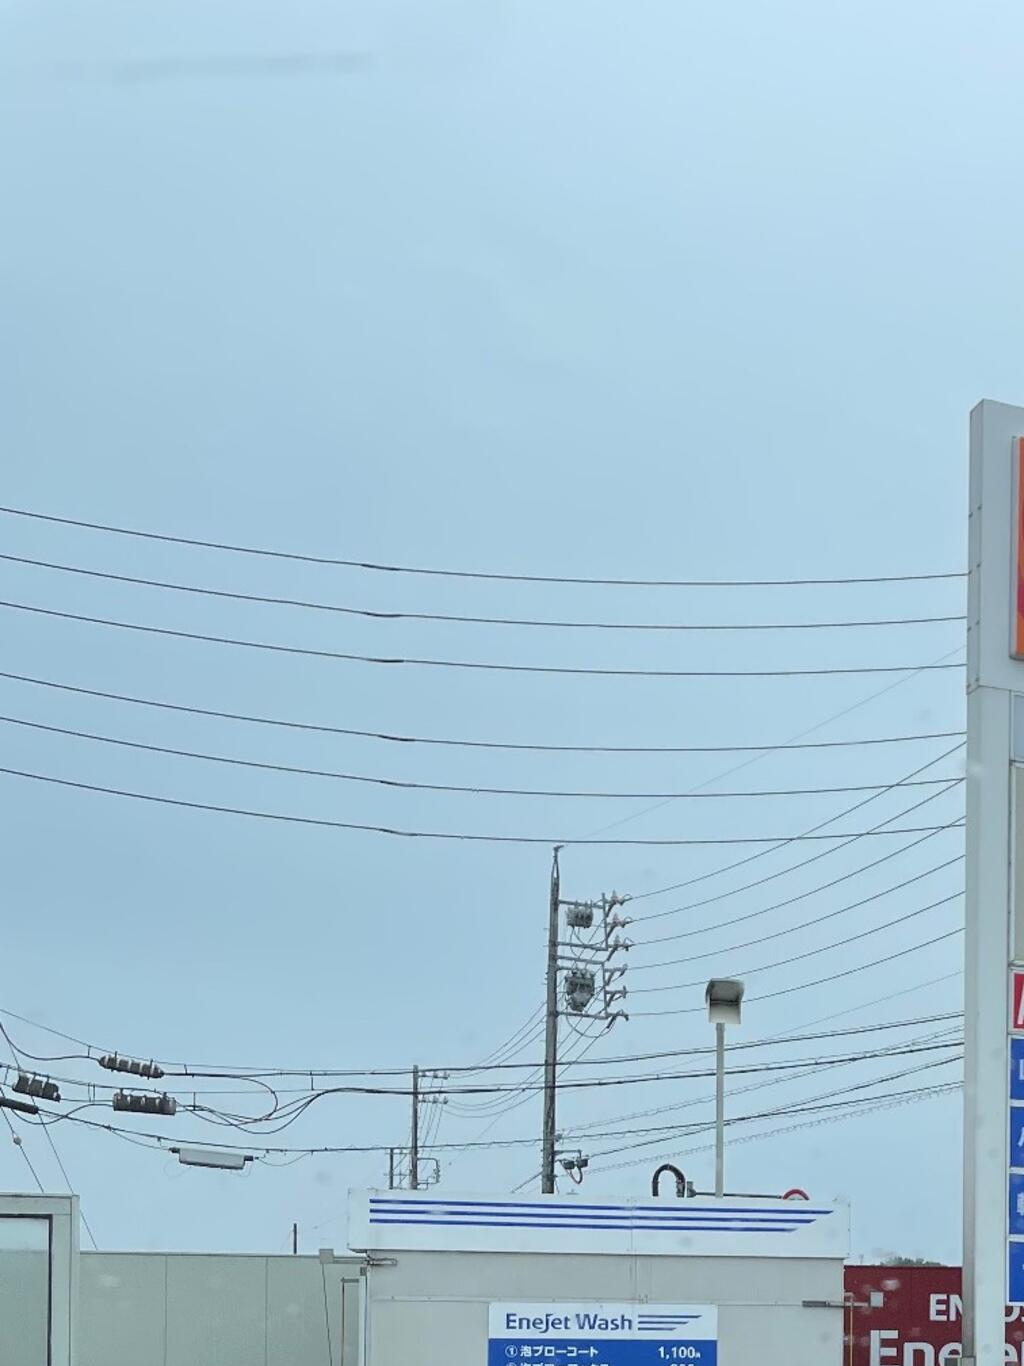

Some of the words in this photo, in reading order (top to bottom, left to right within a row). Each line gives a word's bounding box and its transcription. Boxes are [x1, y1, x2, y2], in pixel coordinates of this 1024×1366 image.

[576, 1314, 632, 1331] Wash
[520, 1345, 599, 1358] 泡ブローコート
